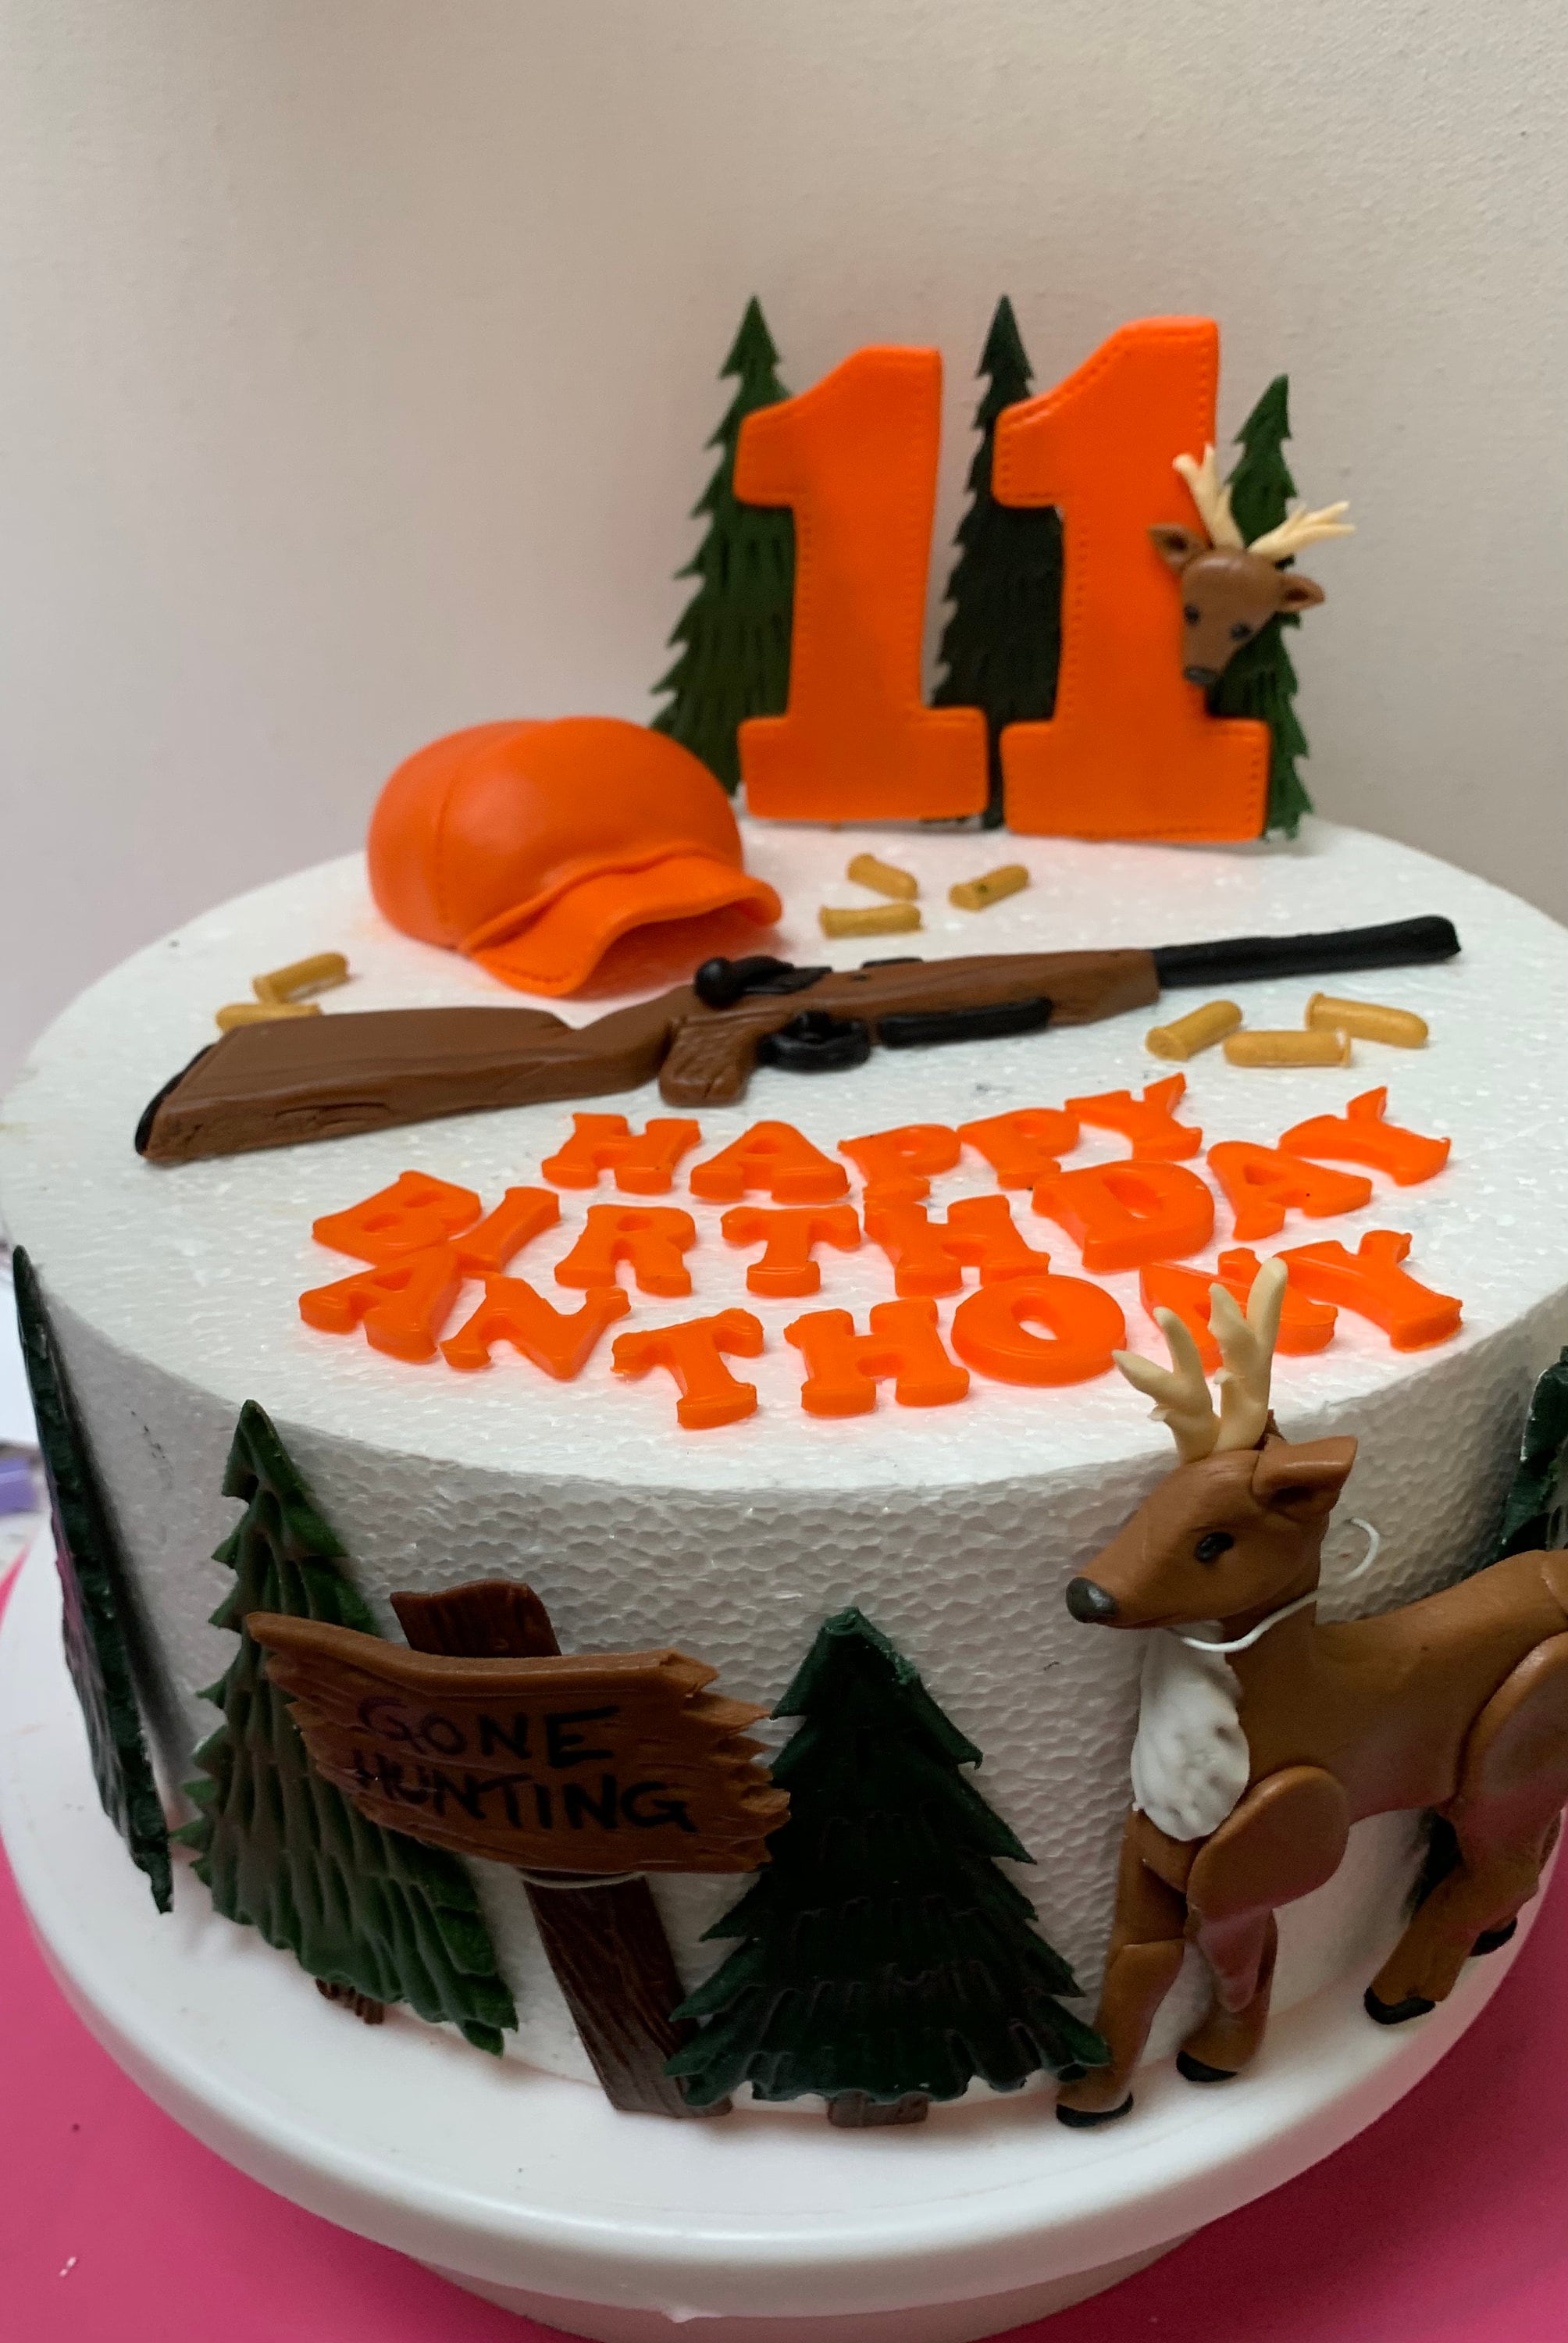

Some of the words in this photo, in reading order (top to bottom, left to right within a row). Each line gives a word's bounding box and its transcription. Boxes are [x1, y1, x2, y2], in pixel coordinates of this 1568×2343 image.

[732, 315, 1271, 844] 11
[312, 1086, 1452, 1298] BIRTHDAY
[540, 1072, 1203, 1204] HAPPY
[299, 1229, 1463, 1430] ANTHONY
[350, 1746, 699, 1834] HUNTING
[358, 1696, 620, 1769] GONE
